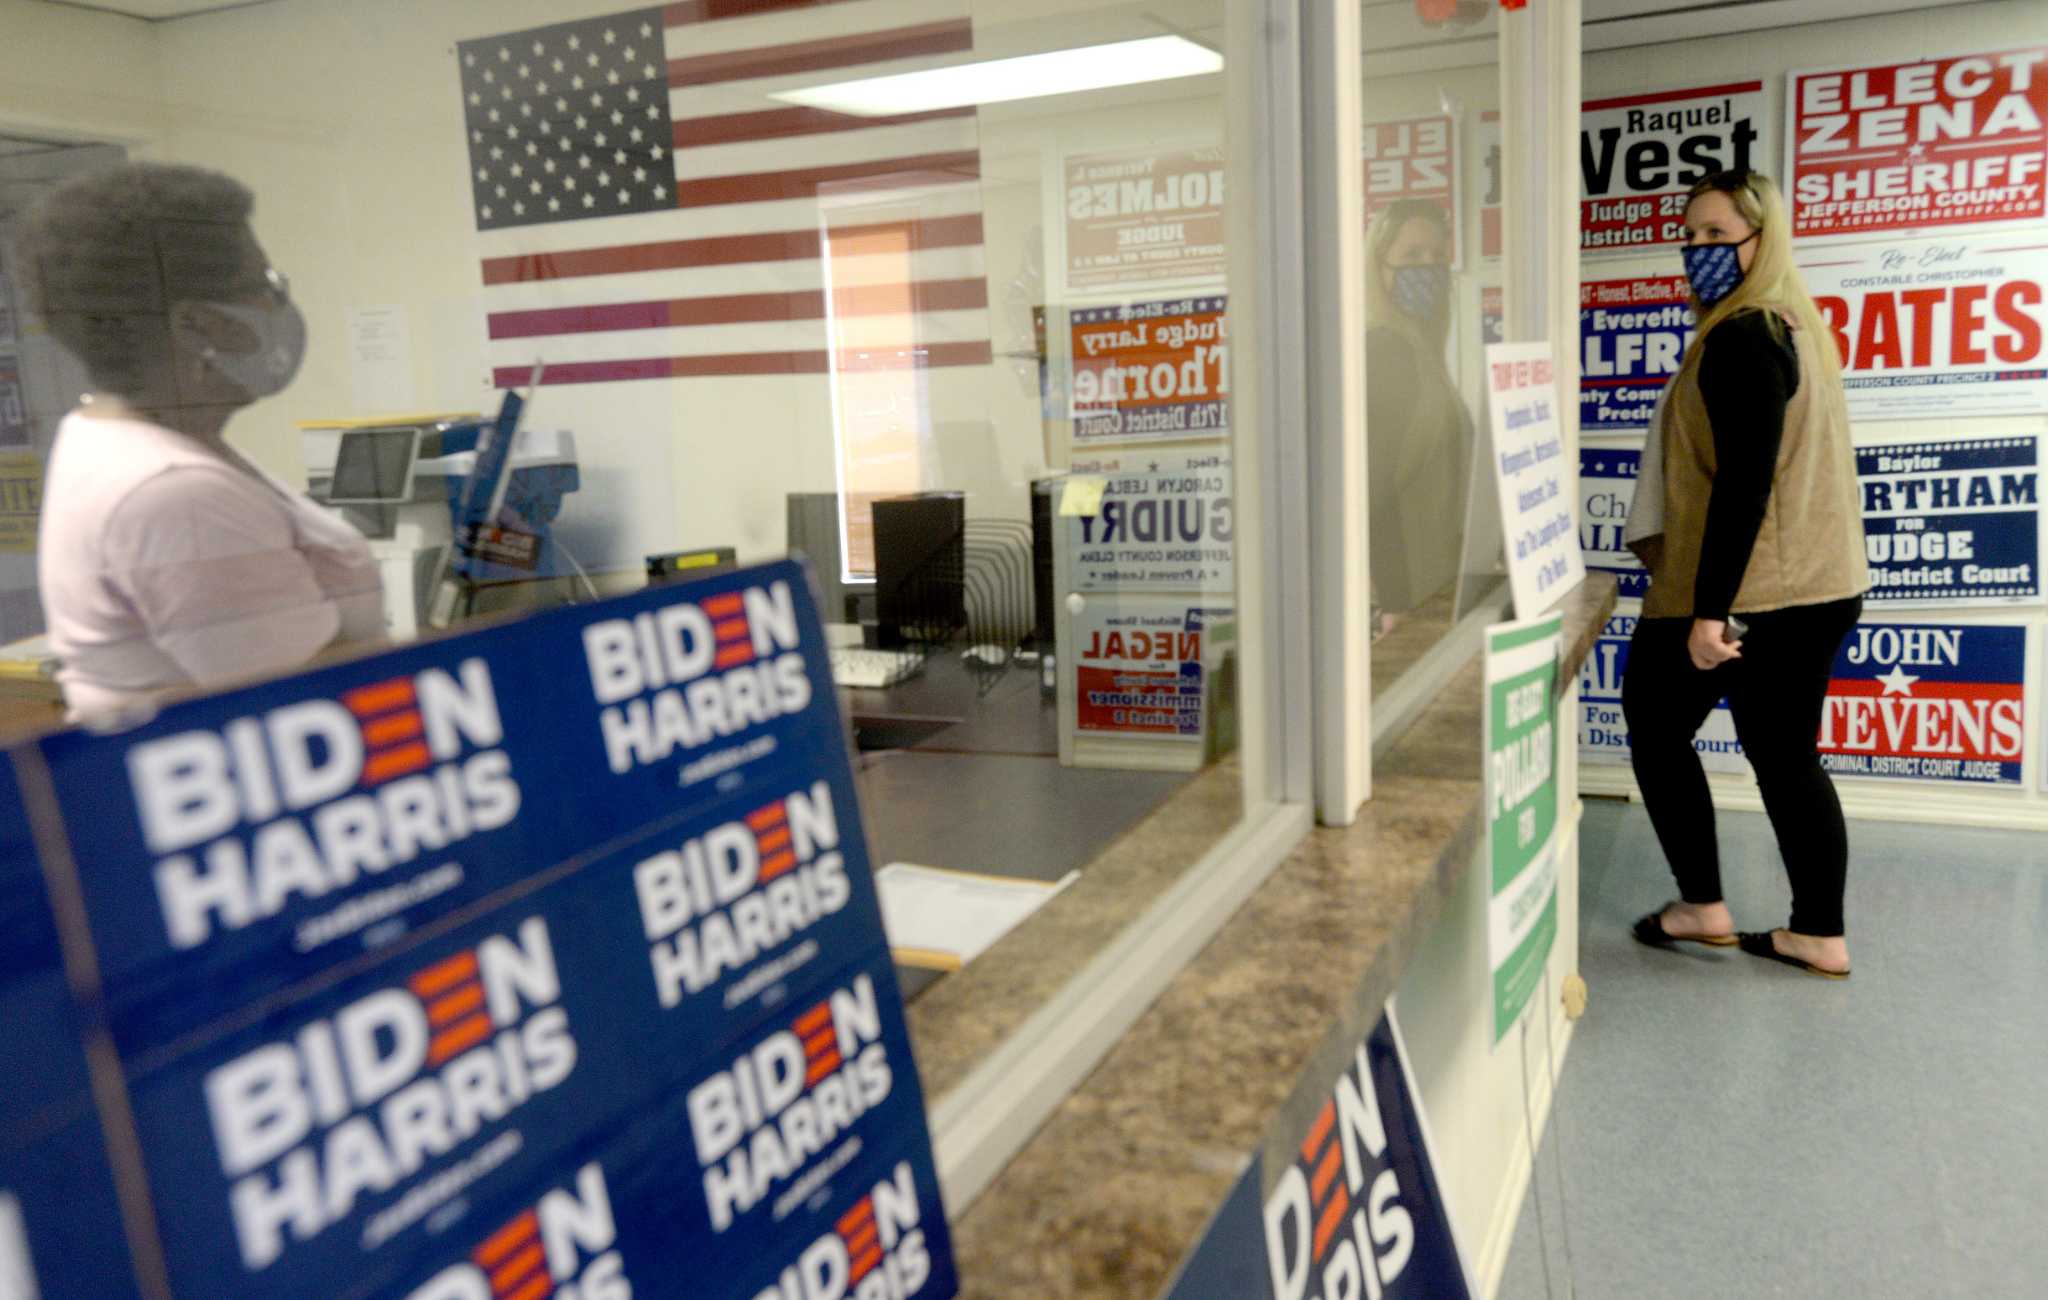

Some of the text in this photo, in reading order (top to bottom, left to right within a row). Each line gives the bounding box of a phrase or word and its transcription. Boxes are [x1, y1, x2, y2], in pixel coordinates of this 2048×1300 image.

[1802, 50, 2046, 115] ELECT
[1626, 98, 1731, 134] Raquel
[1800, 94, 2042, 154] ZENA
[1797, 153, 2045, 204] SHERIFF
[1799, 184, 2039, 219] JEFFERSON COUNTY
[1580, 225, 1653, 246] istrict
[1590, 200, 1652, 223] Judge
[1840, 267, 2005, 289] CONSTABLE CHRISTOPHER
[1593, 306, 1697, 331] Everette
[1580, 331, 1697, 377] LFR
[1877, 455, 1941, 473] Baylor
[1859, 473, 2038, 512] RTHAM
[1895, 518, 1925, 530] FOR
[1867, 564, 2030, 587] District Court
[582, 579, 800, 704] BIDEN
[1847, 628, 1963, 666] JOHN
[600, 652, 812, 774] HARRIS
[1586, 706, 1621, 724] For
[124, 656, 503, 856] BIDEN
[1820, 754, 2001, 779] CRIMINAL DISTRICT COURT JUDGE
[154, 749, 521, 950] HARRIS
[633, 779, 839, 941] BIDEN
[652, 850, 849, 1009] HARRIS
[205, 915, 561, 1176] BIDEN
[686, 972, 881, 1166] BIDEN
[230, 1006, 577, 1271] HARRIS
[703, 1042, 892, 1234] HARRIS
[749, 1160, 920, 1300] IDEN
